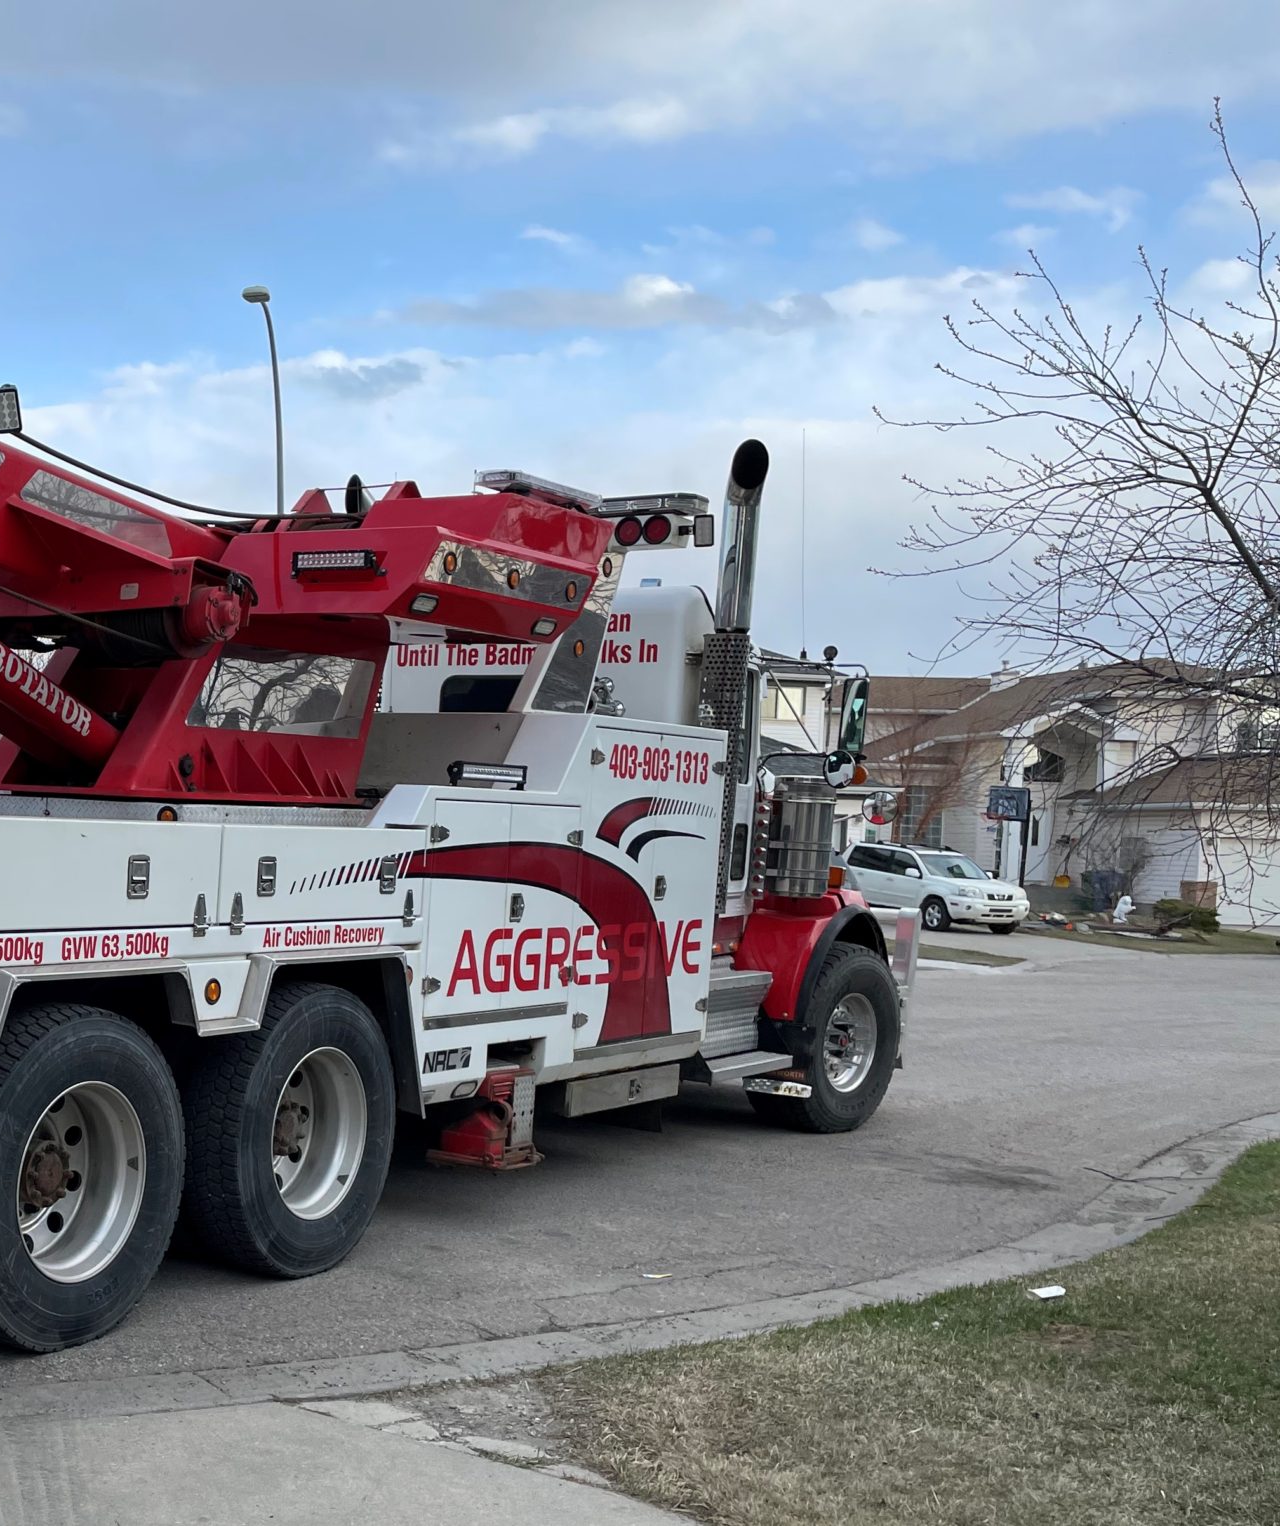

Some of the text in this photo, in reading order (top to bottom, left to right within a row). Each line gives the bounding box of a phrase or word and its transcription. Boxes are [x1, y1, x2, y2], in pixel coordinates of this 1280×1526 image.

[607, 613, 632, 633] an
[396, 639, 659, 667] Until The Badm lks In
[609, 744, 709, 785] 403-903-1313
[61, 935, 97, 961] GVW
[101, 932, 169, 960] 63,500kg
[262, 924, 385, 948] Air Cushion Recovery
[446, 918, 703, 997] AGGRESSIVE
[422, 1049, 458, 1075] NRC
